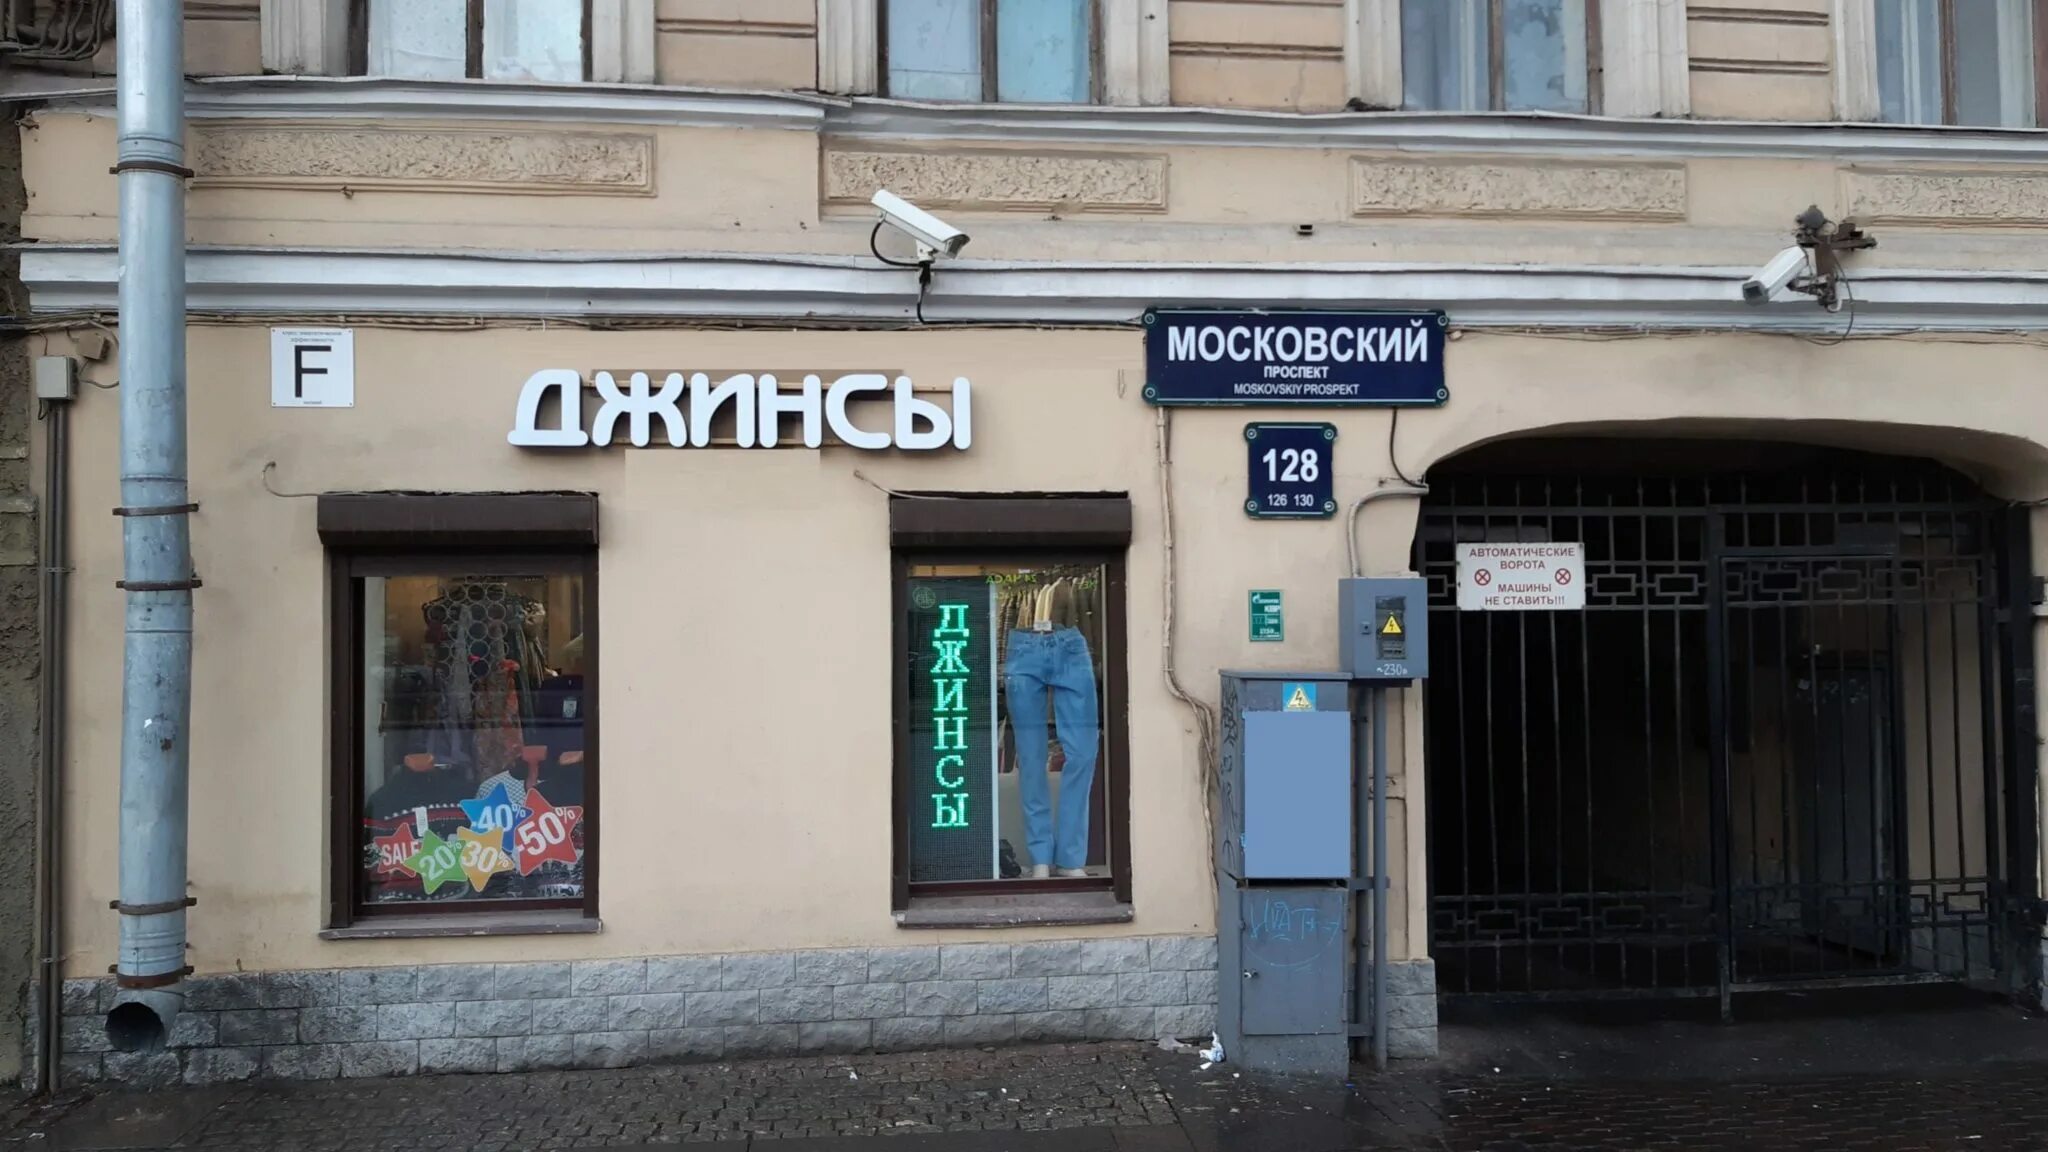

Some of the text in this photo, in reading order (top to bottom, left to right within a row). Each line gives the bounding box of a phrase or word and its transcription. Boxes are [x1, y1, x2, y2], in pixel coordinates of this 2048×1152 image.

[1168, 319, 1428, 362] МОСКОВСКИЙ
[295, 345, 332, 398] F
[1263, 365, 1329, 379] ПРОСПЕКТ
[1234, 383, 1360, 396] MOSKOVSKIY PROSPEKT
[507, 369, 972, 450] ДЖИНСЫ
[1262, 448, 1319, 482] 128
[1267, 494, 1314, 507] 126 130
[1469, 547, 1575, 557] АВТОМАТИЧЕСКИЕ
[1500, 560, 1546, 570] ВОРОТА
[1498, 584, 1552, 593] МАШИНЫ
[1485, 596, 1565, 606] НЕ СТАВИТЬ!!!
[930, 604, 970, 828] ДЖИНСЫ
